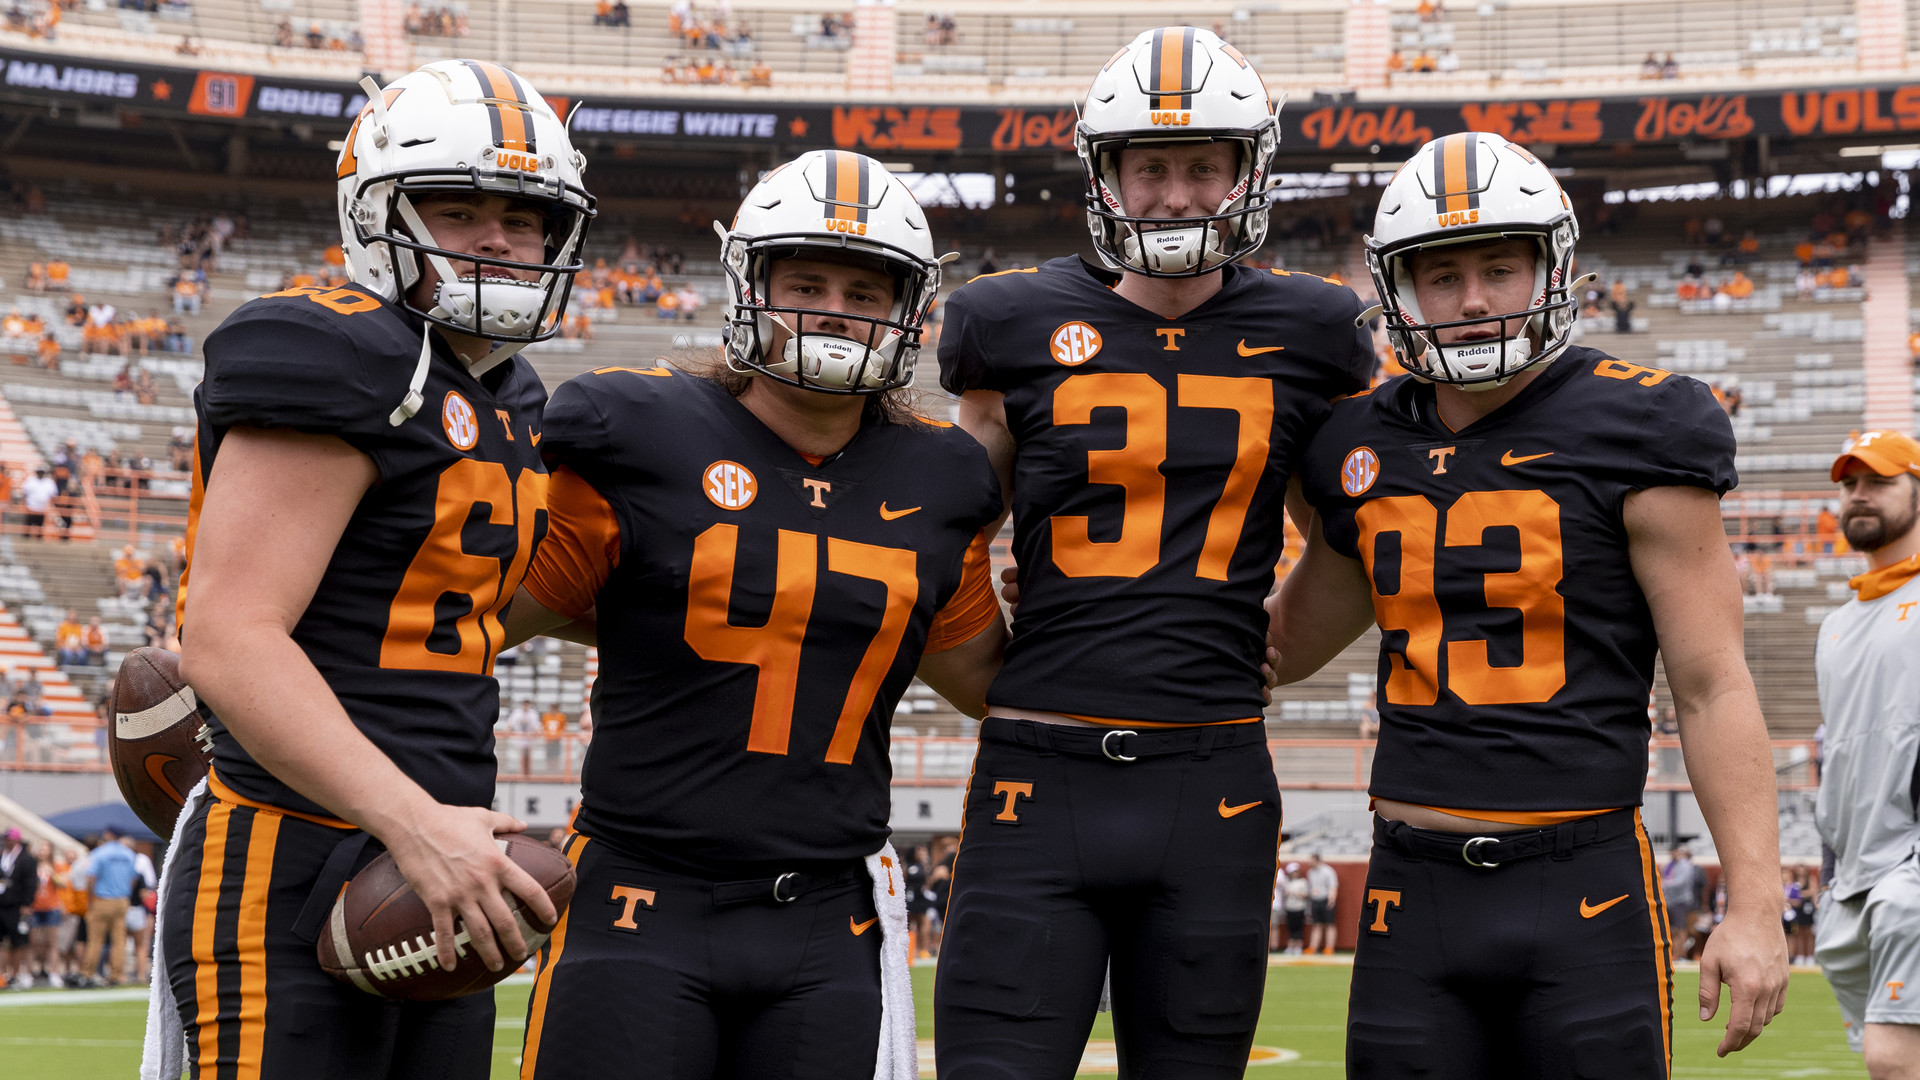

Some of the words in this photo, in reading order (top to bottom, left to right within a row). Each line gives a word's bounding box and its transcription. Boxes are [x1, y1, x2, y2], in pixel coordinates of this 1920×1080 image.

[5, 60, 138, 98] MAJORS
[206, 77, 237, 112] 91
[257, 86, 343, 117] DOUG
[1151, 112, 1191, 126] VOLS
[1781, 86, 1920, 135] VOLS
[573, 107, 679, 135] REGGIE
[684, 112, 777, 137] WHITE
[1301, 104, 1433, 149] Vols
[496, 152, 539, 173] VOLS
[825, 218, 868, 236] VOLS
[1438, 209, 1479, 227] VOLS
[1156, 235, 1185, 244] Riddell
[822, 342, 852, 353] Riddell
[1055, 324, 1099, 364] SEC
[1156, 328, 1185, 350] T
[1457, 346, 1496, 358] Riddell
[446, 396, 477, 446] SEC
[496, 409, 516, 441] T
[1050, 373, 1274, 581] 37
[1343, 451, 1376, 493] SEC
[1429, 446, 1456, 475] T
[708, 463, 752, 507] SEC
[803, 478, 831, 508] T
[1354, 490, 1566, 705] 93
[684, 522, 919, 765] 47
[990, 779, 1034, 822] T
[610, 884, 656, 930] T
[1367, 888, 1402, 932] T
